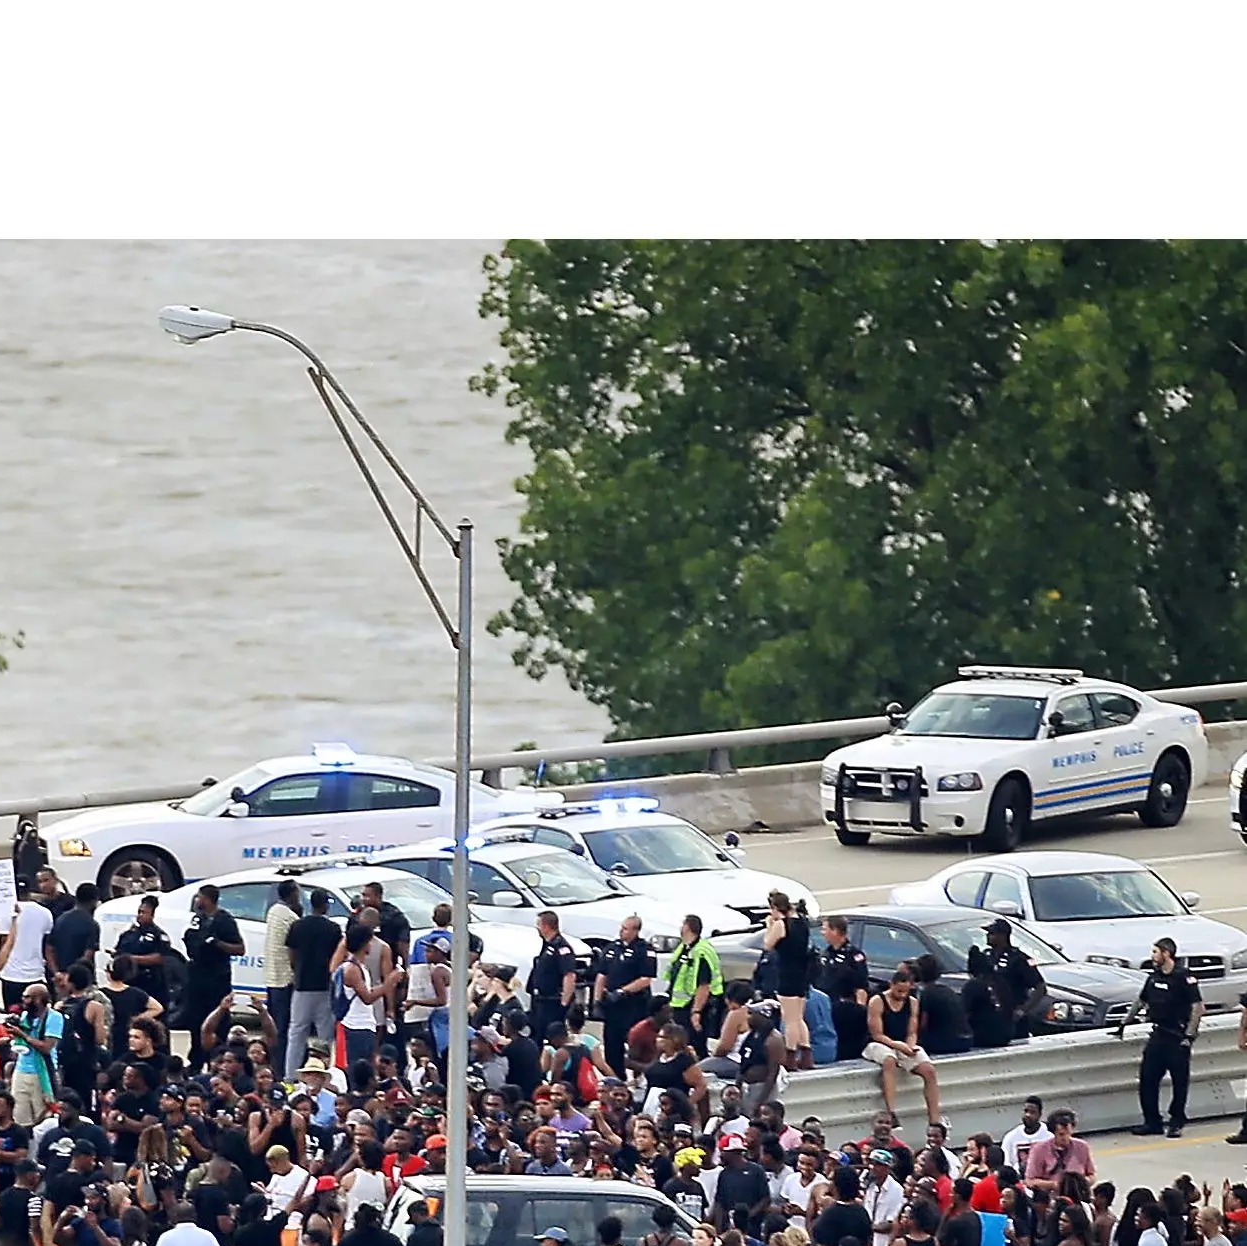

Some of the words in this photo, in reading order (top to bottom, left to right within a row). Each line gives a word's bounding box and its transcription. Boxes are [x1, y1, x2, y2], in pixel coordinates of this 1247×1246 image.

[1052, 751, 1096, 767] MEMPHIS
[1114, 742, 1144, 757] POLICE
[243, 846, 330, 858] MEMPHIS
